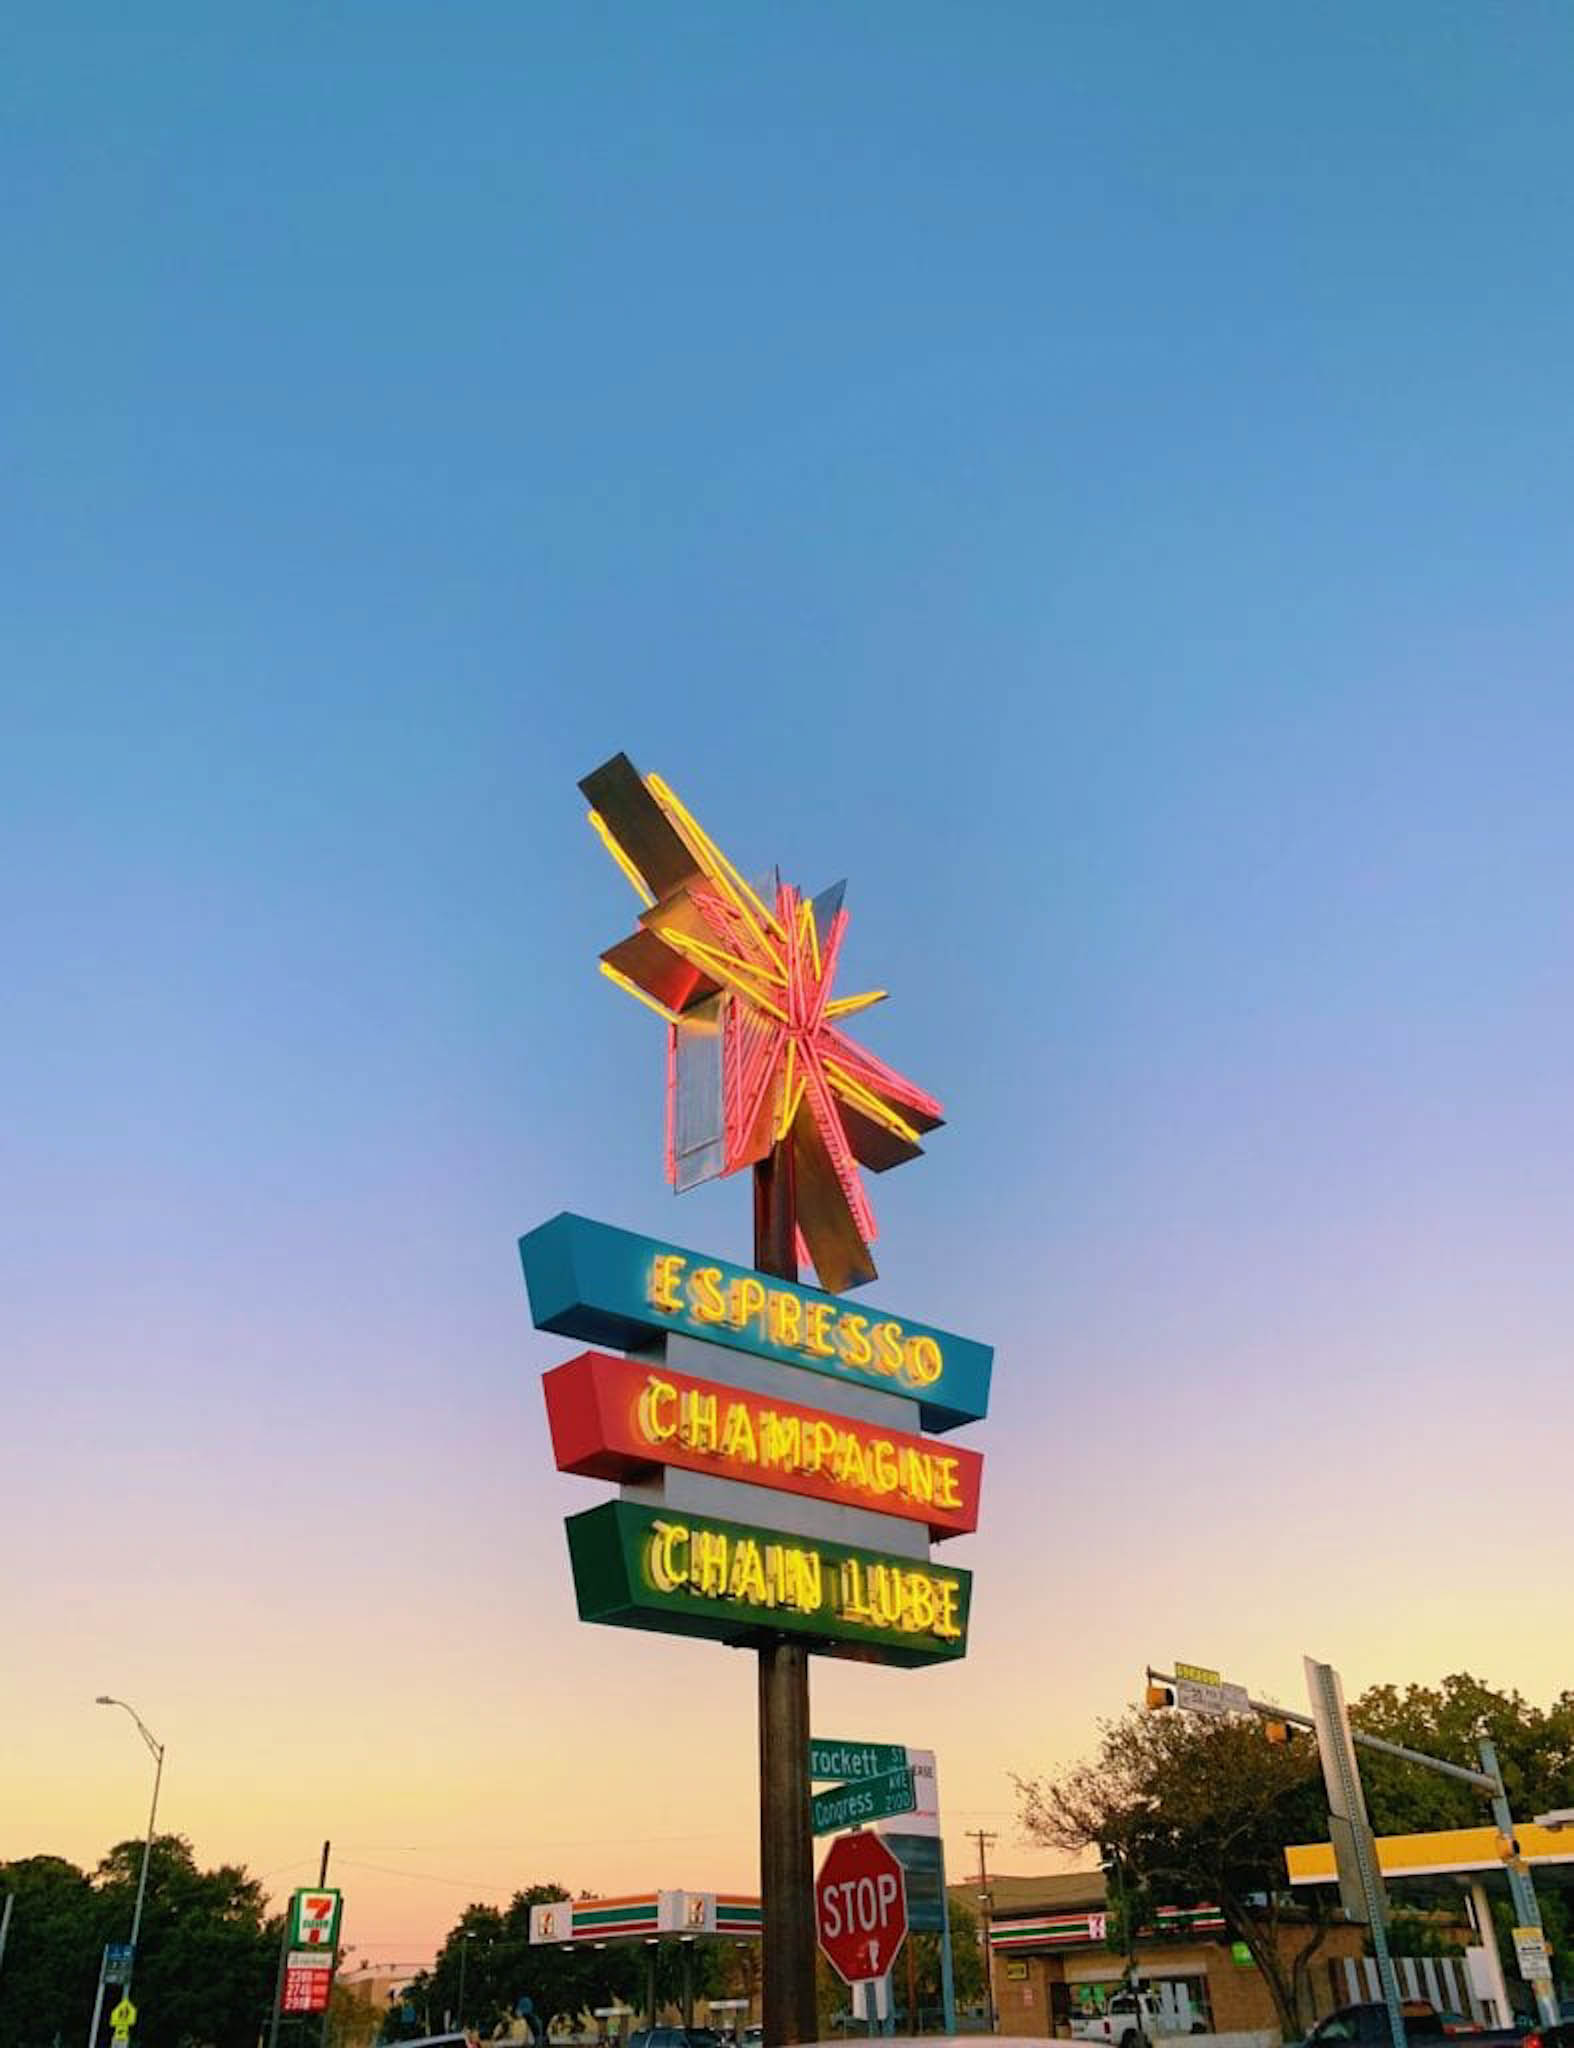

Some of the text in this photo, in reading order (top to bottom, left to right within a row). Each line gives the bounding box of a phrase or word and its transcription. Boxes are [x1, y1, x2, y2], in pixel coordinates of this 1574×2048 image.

[649, 1254, 943, 1387] ESPRESSO
[639, 1376, 963, 1510] CHAMPAGNE
[646, 1520, 962, 1640] CHAIN LUBE
[811, 1747, 904, 1776] rockett ST
[889, 1771, 908, 1790] AVE
[912, 1765, 933, 1778] EASE
[815, 1792, 873, 1827] Congress
[823, 1873, 897, 1938] STOP
